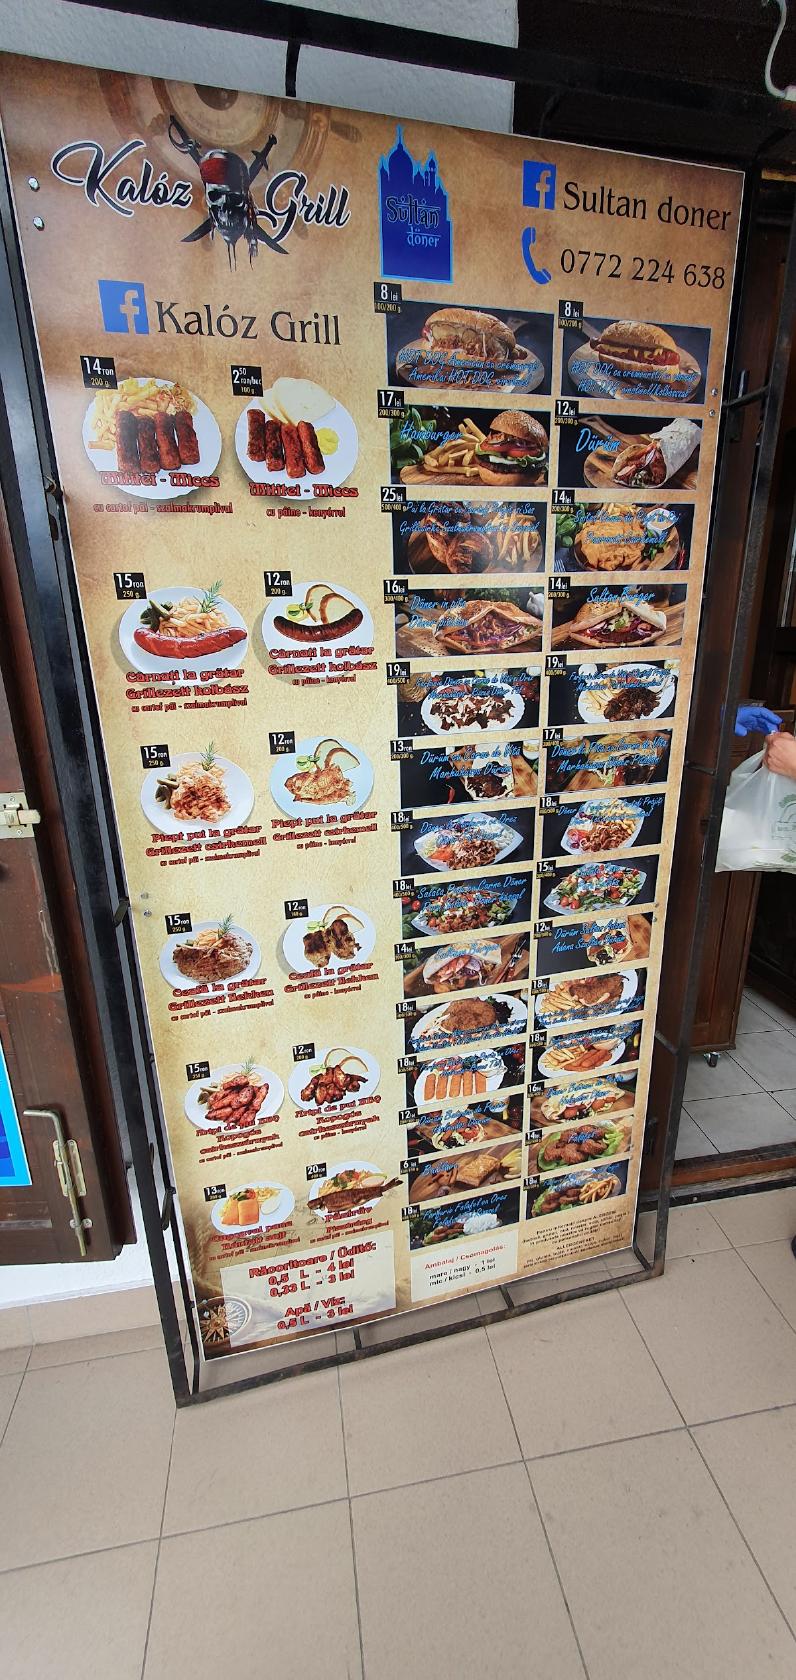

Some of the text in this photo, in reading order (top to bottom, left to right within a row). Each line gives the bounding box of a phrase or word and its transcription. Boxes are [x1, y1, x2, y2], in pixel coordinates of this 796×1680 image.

[51, 139, 350, 245] Kalóz Grill
[563, 181, 732, 231] Sultan doner
[407, 230, 441, 248] döner
[560, 248, 726, 290] 0772 224 638
[380, 284, 388, 300] 8
[565, 302, 571, 317] 8
[154, 300, 341, 346] Kalóz Grill
[83, 357, 102, 375] 14
[90, 378, 104, 386] 200
[379, 391, 394, 406] 17
[556, 401, 569, 416] 12
[400, 420, 464, 449] Hamburger
[576, 428, 621, 452] Dürüm
[382, 488, 396, 502] 25
[553, 490, 566, 504] 14
[116, 574, 132, 588] 15
[266, 572, 280, 586] 12
[550, 578, 562, 590] 14
[385, 580, 398, 594] 16
[320, 646, 332, 658] la
[335, 646, 375, 659] grătar
[268, 660, 378, 676] Grillezett kolbász
[388, 663, 400, 676] 19
[547, 657, 558, 669] 19
[182, 668, 197, 680] la
[200, 667, 245, 682] grătar
[126, 684, 250, 700] Grillezett kolbász
[271, 734, 284, 745] 12
[544, 728, 555, 740] 17
[144, 746, 158, 759] 15
[392, 741, 404, 752] 13
[420, 750, 448, 766] Dürüm
[541, 797, 552, 808] 18
[393, 812, 404, 823] 18
[538, 862, 548, 872] 15
[394, 880, 406, 891] 18
[287, 902, 298, 912] 12
[167, 916, 181, 927] 15
[536, 922, 546, 932] 12
[396, 944, 407, 954] 14
[534, 980, 543, 990] 18
[397, 1002, 408, 1012] 18
[530, 1034, 540, 1043] 18
[293, 1046, 304, 1056] 12
[188, 1064, 200, 1074] 15
[399, 1058, 409, 1068] 18
[400, 1110, 410, 1120] 12
[307, 1166, 318, 1175] 20
[206, 1186, 218, 1197] 13
[404, 1206, 414, 1216] 18
[326, 1262, 336, 1273] 4
[338, 1258, 354, 1270] lei
[327, 1274, 336, 1284] 3
[339, 1270, 355, 1282] lei
[326, 1309, 336, 1318] 3
[338, 1304, 354, 1316] lei
